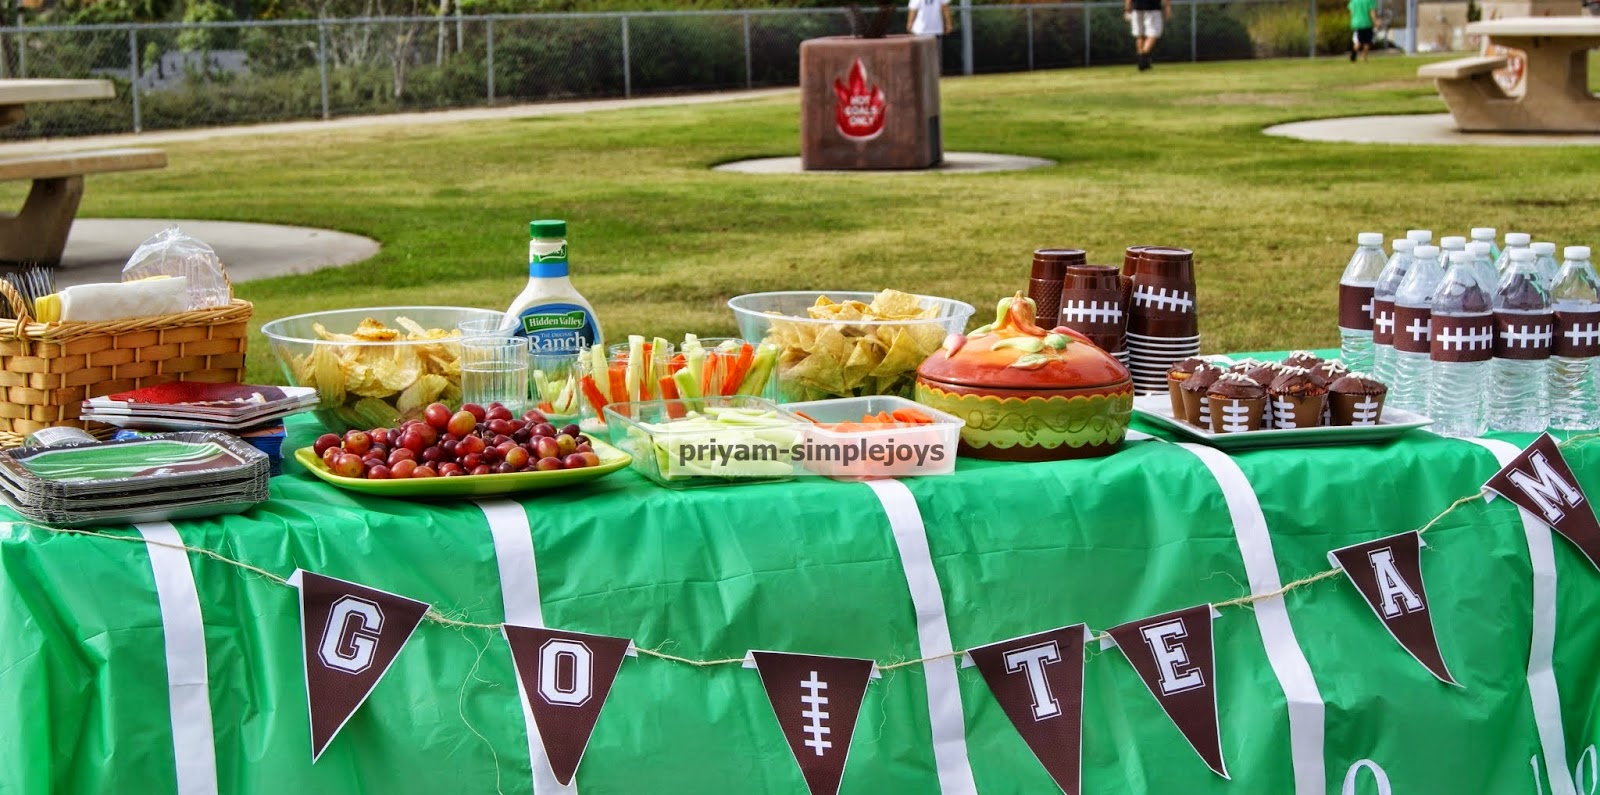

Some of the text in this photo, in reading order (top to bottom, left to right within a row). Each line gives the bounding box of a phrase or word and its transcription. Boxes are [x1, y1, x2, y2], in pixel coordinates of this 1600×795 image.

[529, 317, 582, 327] Hidden Valley
[527, 331, 588, 352] Ranch
